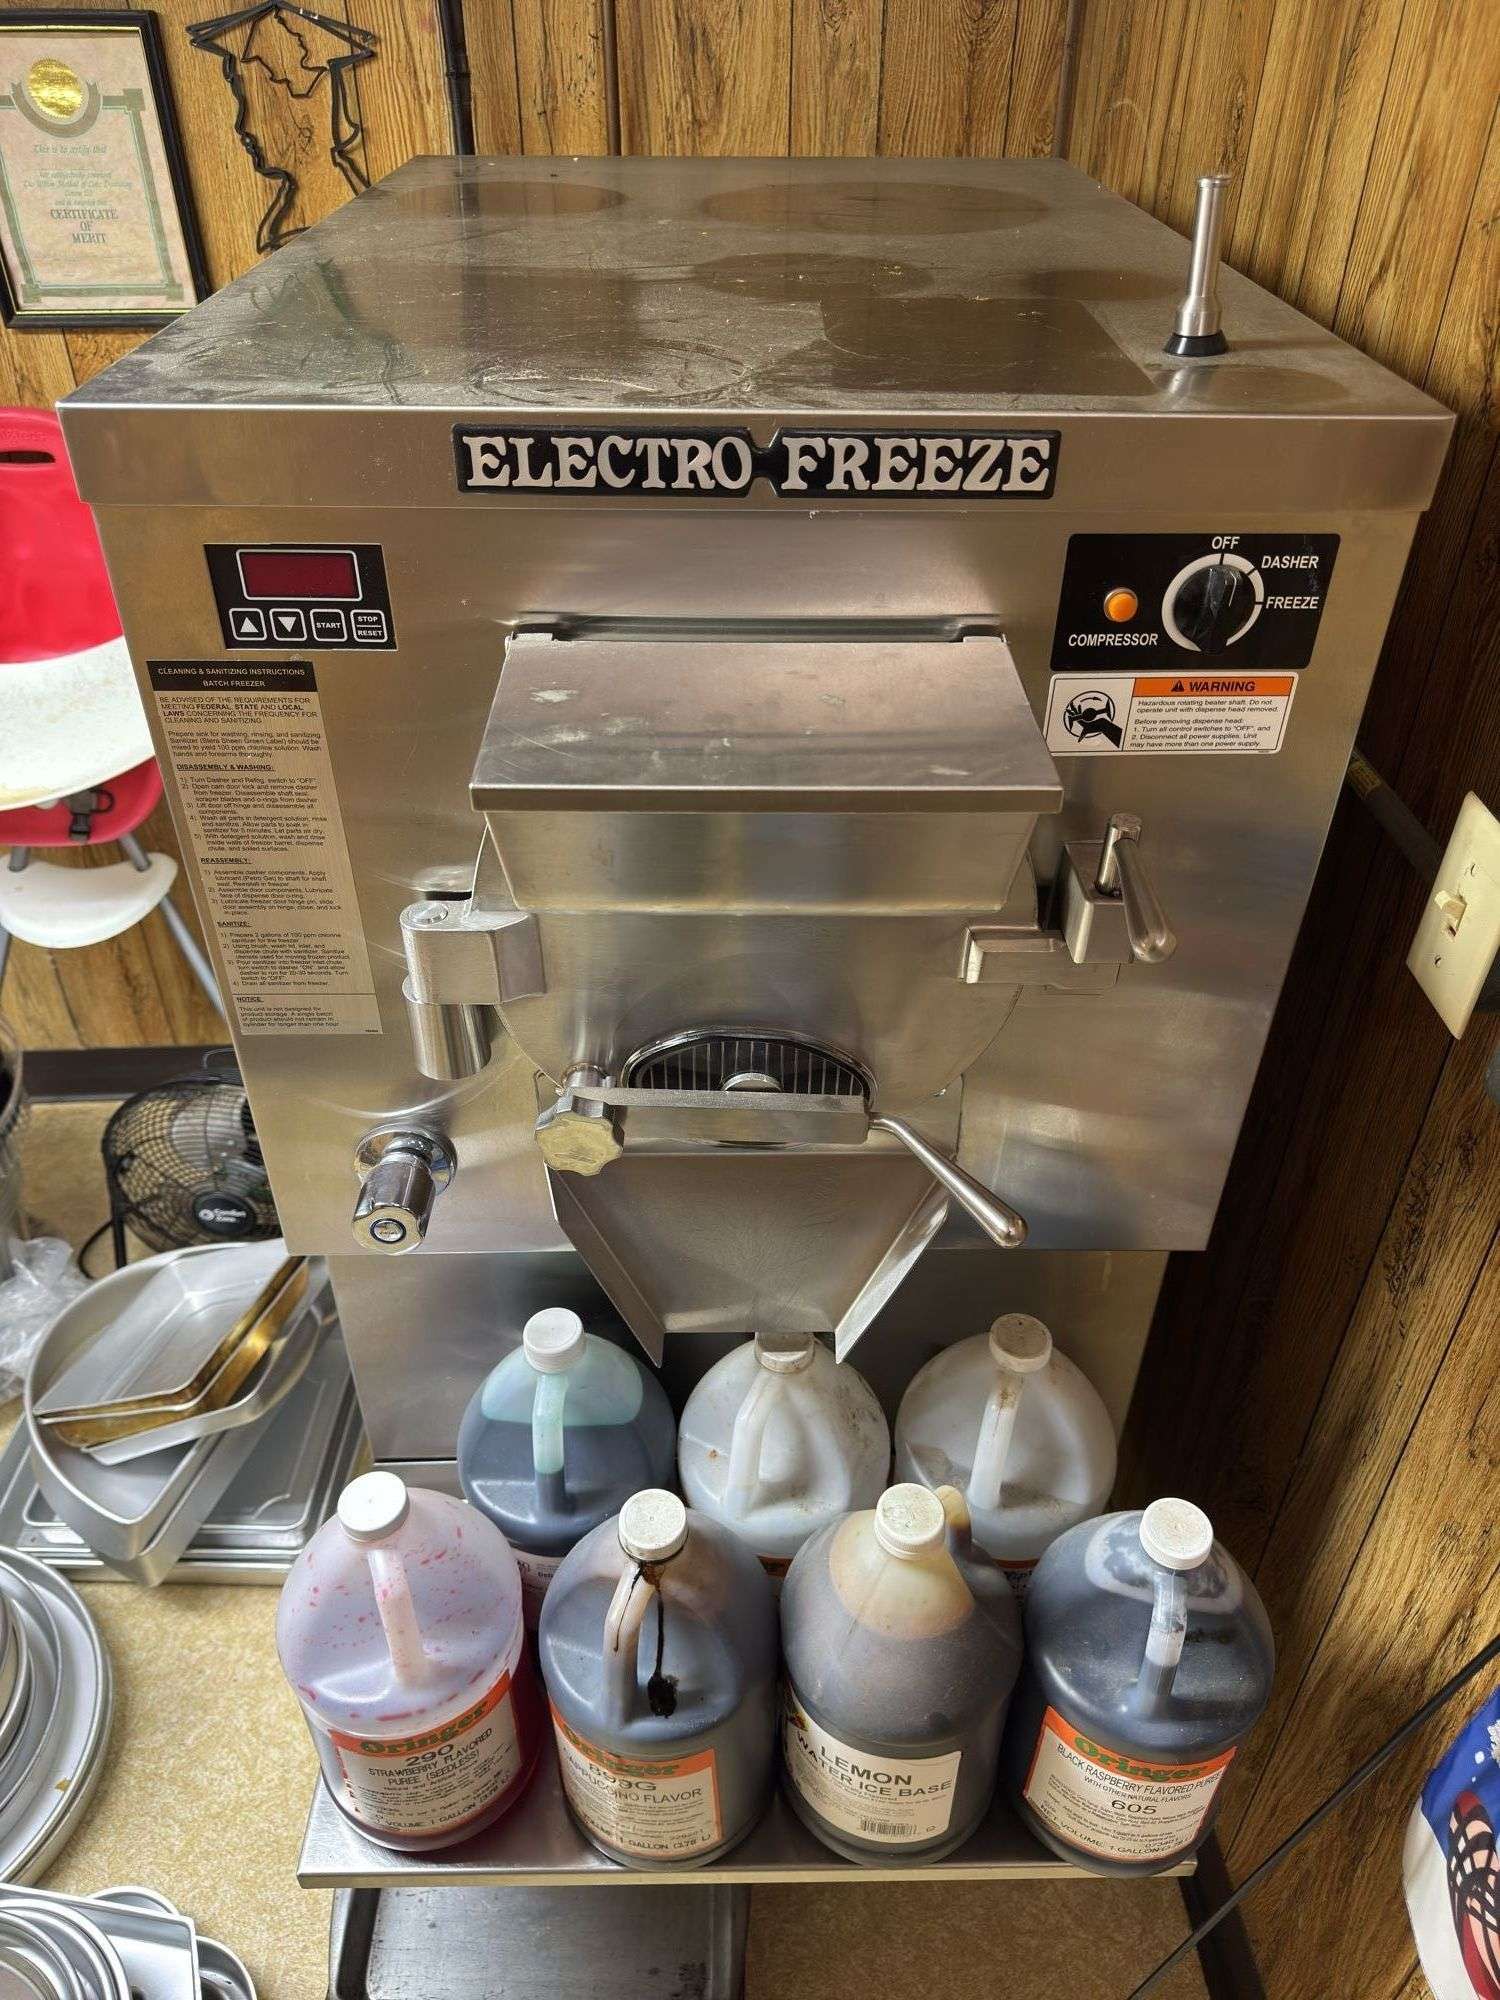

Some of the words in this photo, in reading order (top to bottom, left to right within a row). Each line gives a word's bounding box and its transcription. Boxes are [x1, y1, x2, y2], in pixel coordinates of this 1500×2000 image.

[50, 209, 119, 220] CERTIFICATE
[80, 220, 93, 232] OF
[72, 233, 106, 244] MERIT
[462, 434, 753, 490] ELECTRO
[780, 435, 1051, 491] FREEZE
[1211, 536, 1240, 550] OFF
[1261, 555, 1319, 570] DASHER
[1265, 596, 1319, 610] FREEZE
[1068, 633, 1159, 647] COMPRESSOR
[158, 668, 197, 676] CLEANING
[198, 668, 205, 676] &
[206, 668, 248, 676] SANITIZING
[249, 668, 305, 676] INSTRUCTIONS
[1189, 680, 1256, 692] WARNING
[1195, 706, 1225, 714] dispense
[1191, 718, 1223, 726] dispense
[368, 1760, 438, 1778] STRAWBERRY
[443, 1728, 493, 1765] FLAVORED
[404, 1744, 455, 1767] 290
[388, 1776, 421, 1786] PUREE
[426, 1749, 480, 1781] (SEEDLESS)
[796, 1731, 853, 1786] WATER
[858, 1781, 893, 1797] ICE
[899, 1779, 953, 1797] BASE
[821, 1745, 913, 1786] LEMON
[1056, 1743, 1085, 1770] BLACK
[1085, 1764, 1144, 1793] RASPBERRY
[1144, 1783, 1194, 1795] FLAVORED
[1084, 1775, 1101, 1788] WITH
[1102, 1785, 1127, 1799] OTHER
[643, 1788, 702, 1804] FLAVOR
[1111, 1799, 1158, 1815] 605
